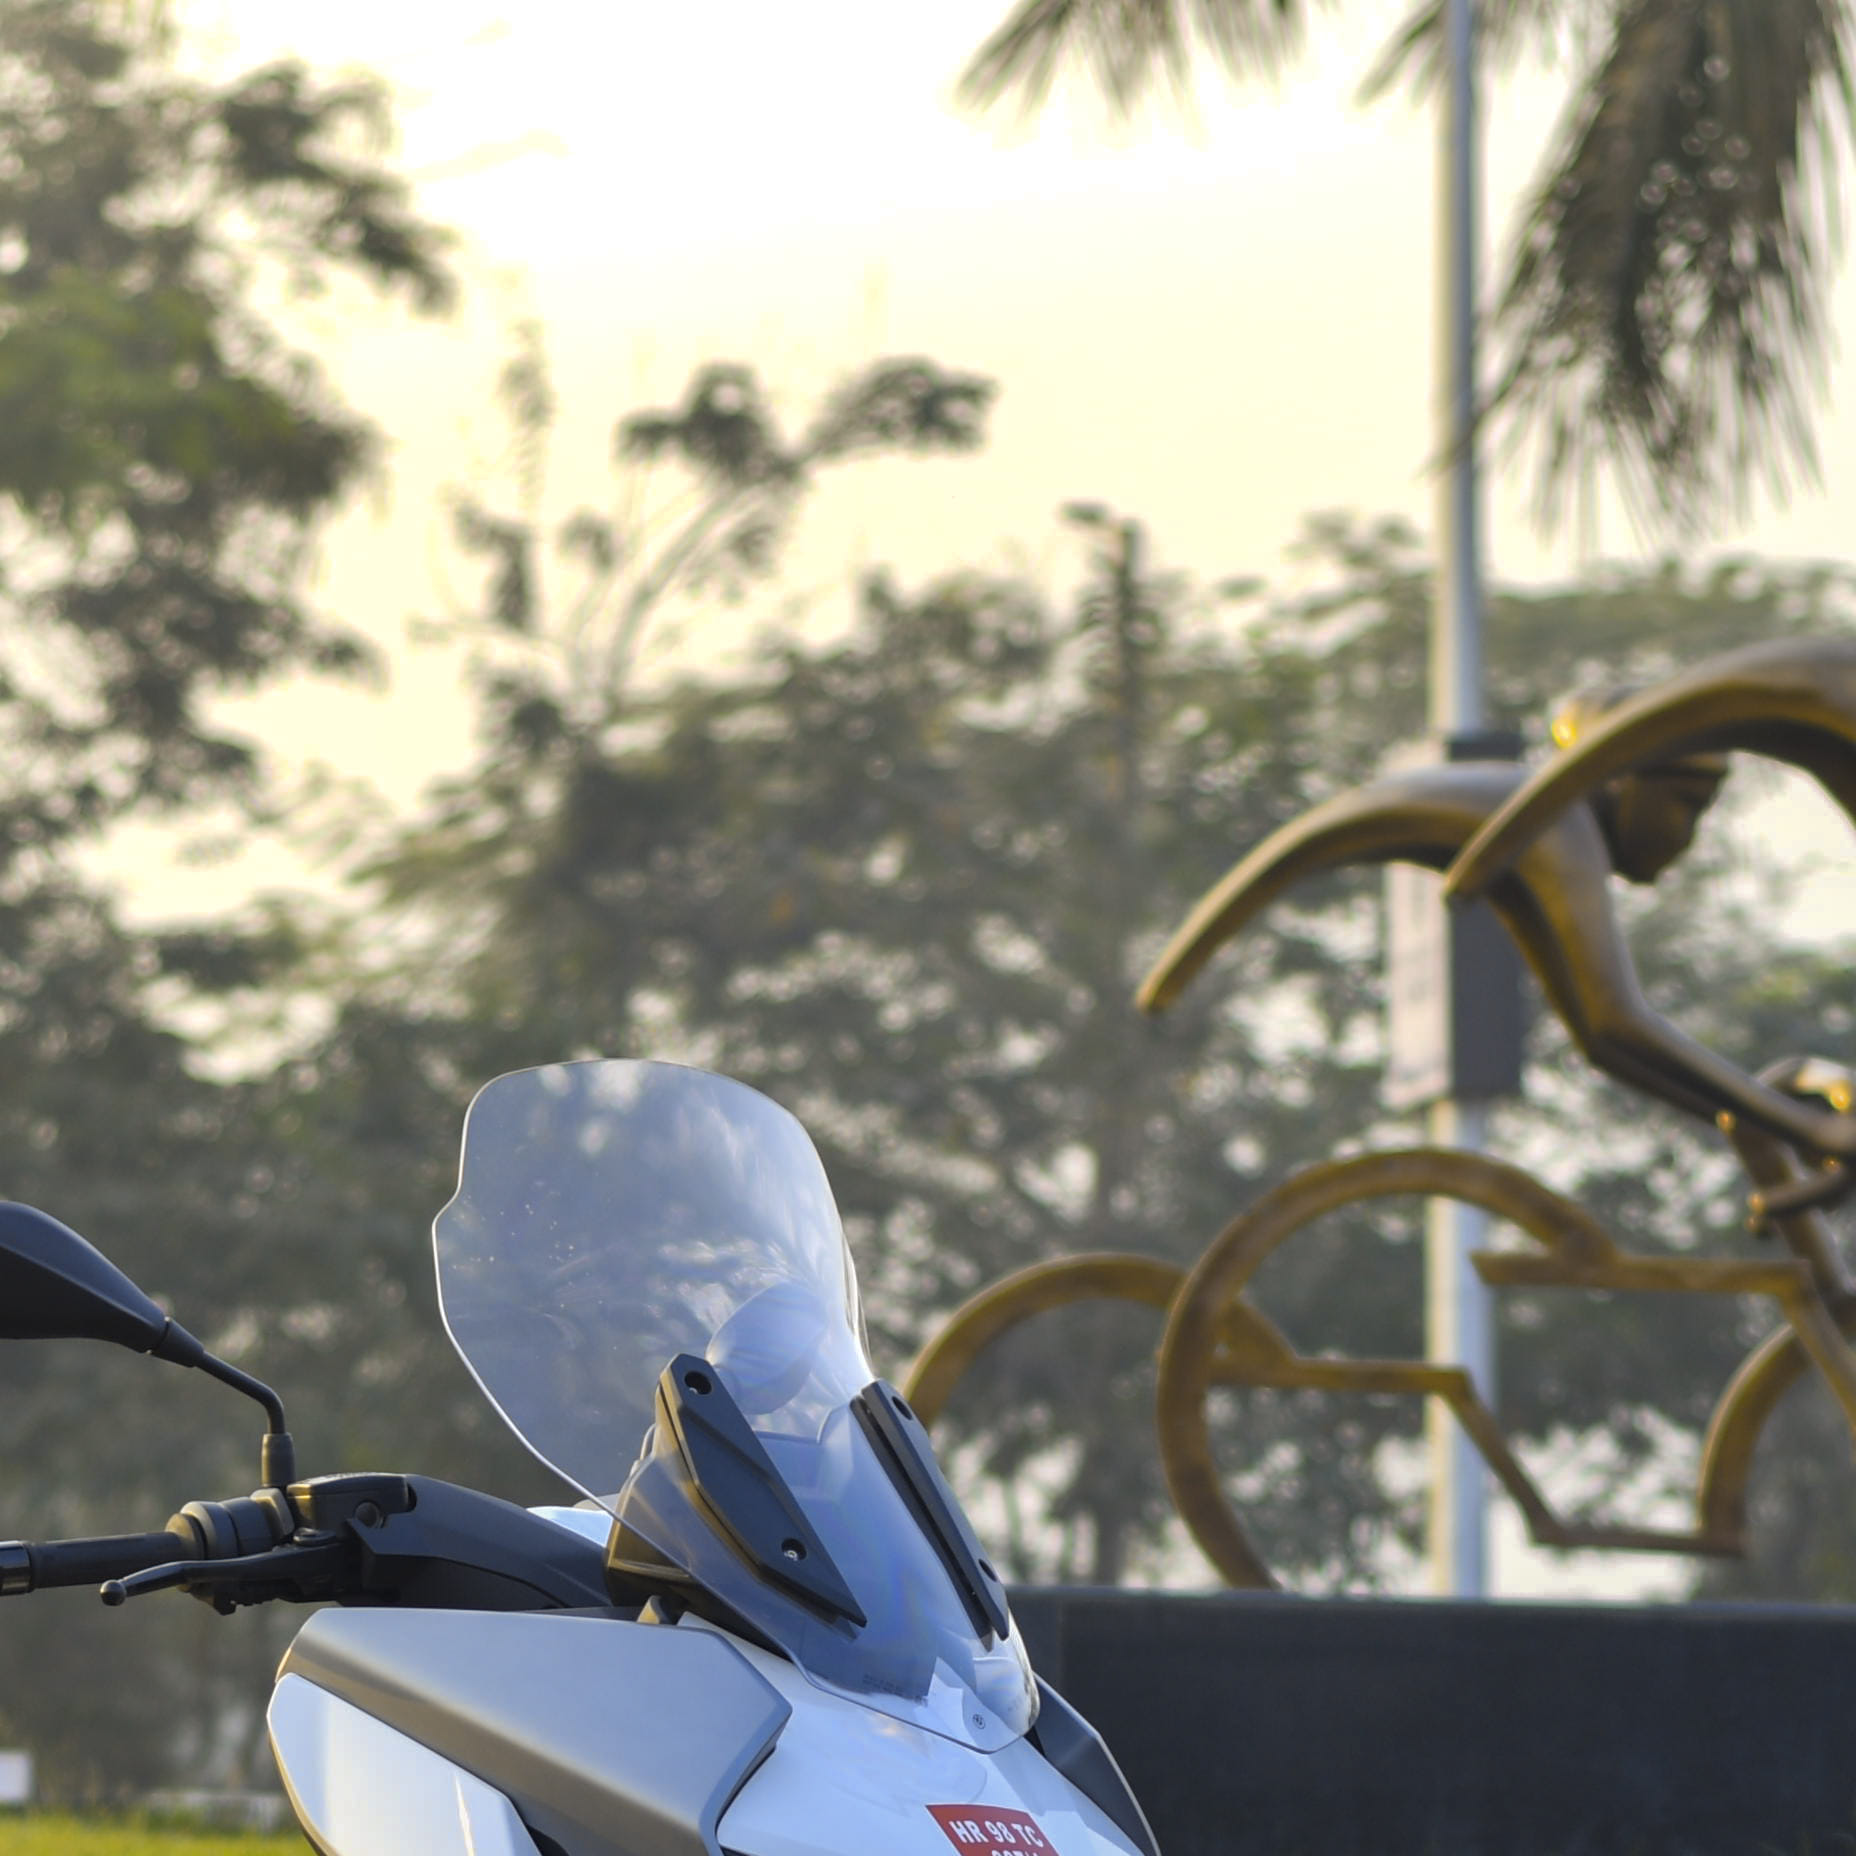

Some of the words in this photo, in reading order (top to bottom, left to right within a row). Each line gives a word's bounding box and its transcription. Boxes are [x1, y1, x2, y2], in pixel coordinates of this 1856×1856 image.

[948, 1820, 989, 1844] HR
[984, 1820, 1016, 1844] 98
[1010, 1822, 1044, 1848] TC
